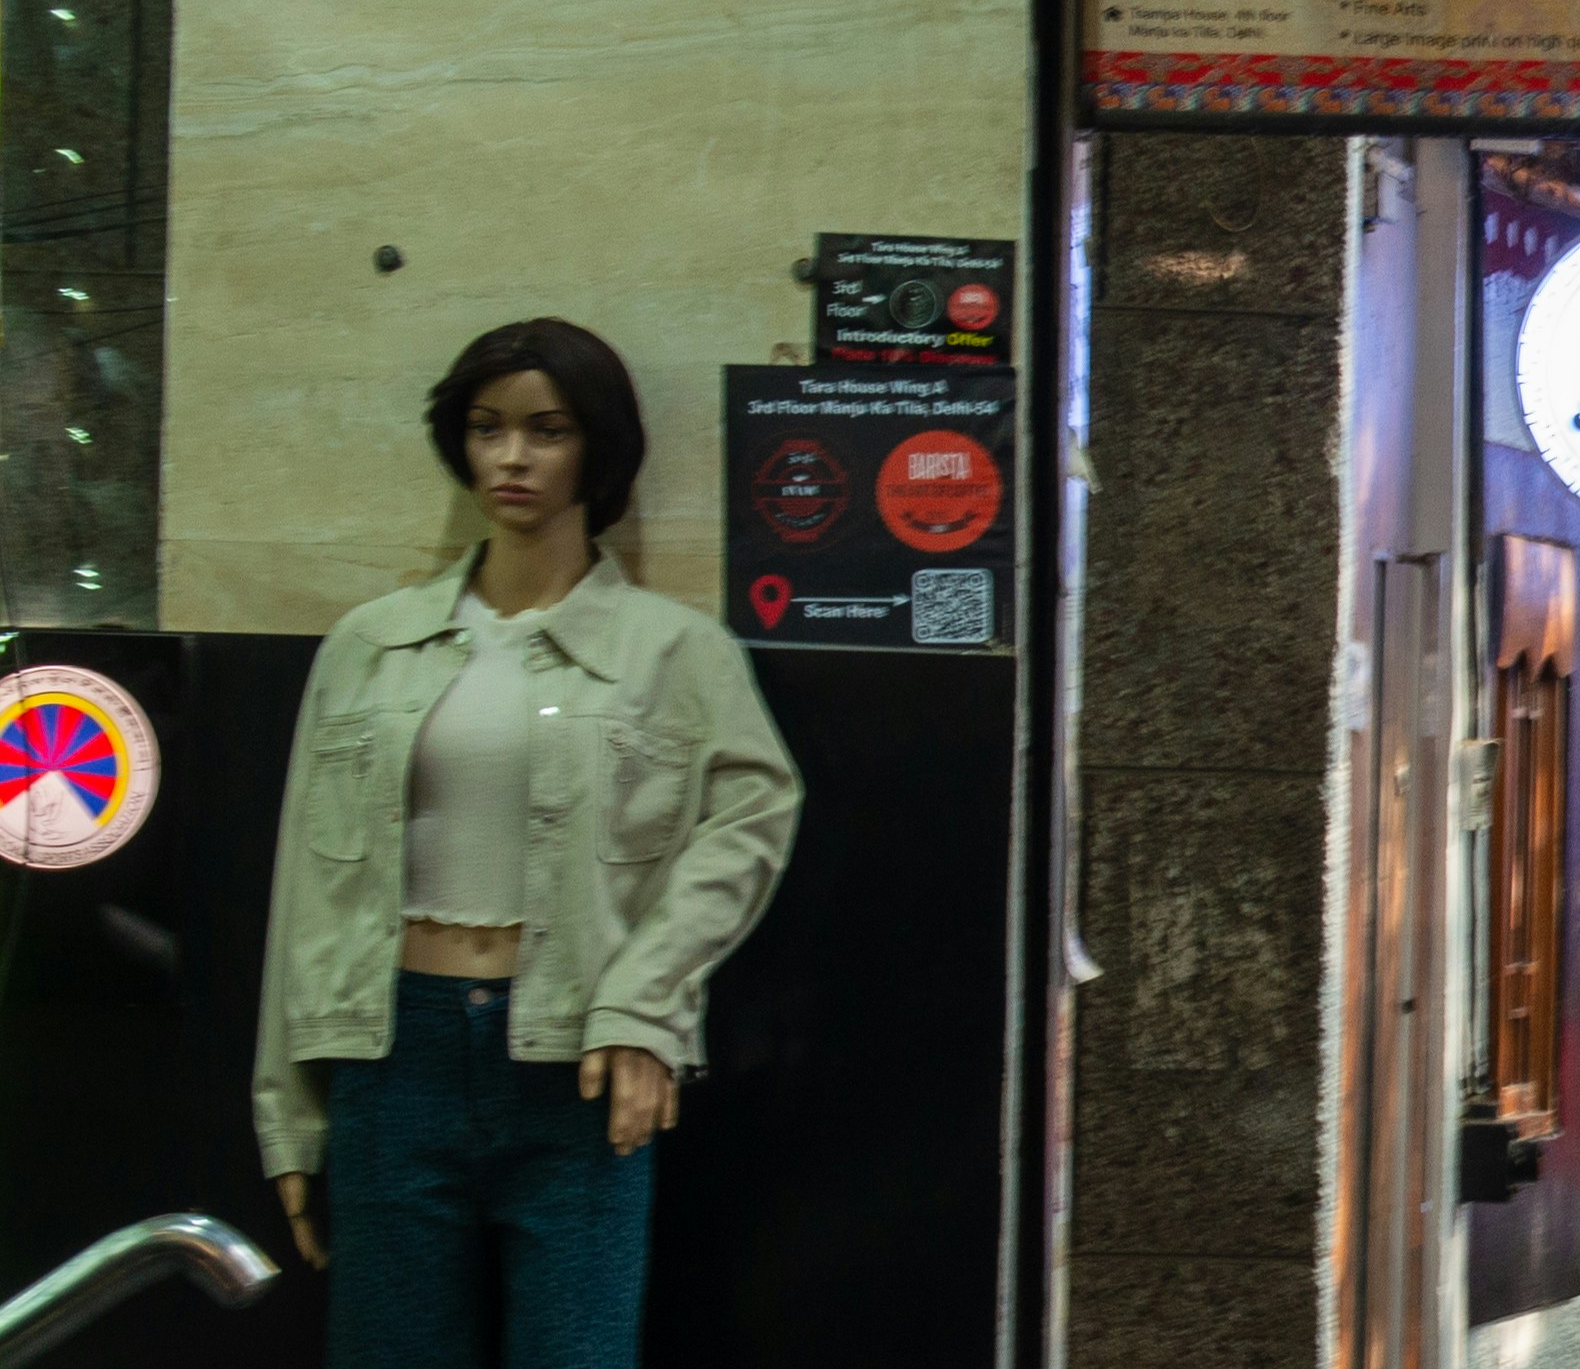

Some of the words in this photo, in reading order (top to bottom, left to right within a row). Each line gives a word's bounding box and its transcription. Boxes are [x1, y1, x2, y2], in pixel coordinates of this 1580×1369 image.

[1353, 0, 1390, 16] Fine
[832, 280, 864, 295] 3rd
[825, 302, 869, 319] Floor
[836, 328, 947, 349] Introductory
[946, 331, 995, 349] Offer
[799, 379, 837, 394] Tara
[837, 379, 888, 395] House
[889, 380, 929, 398] Wing
[747, 399, 776, 415] 3rd
[776, 399, 817, 415] Floor
[819, 399, 868, 418] Manju
[869, 400, 895, 415] Ka
[804, 602, 843, 621] Scan
[844, 604, 890, 621] Here
